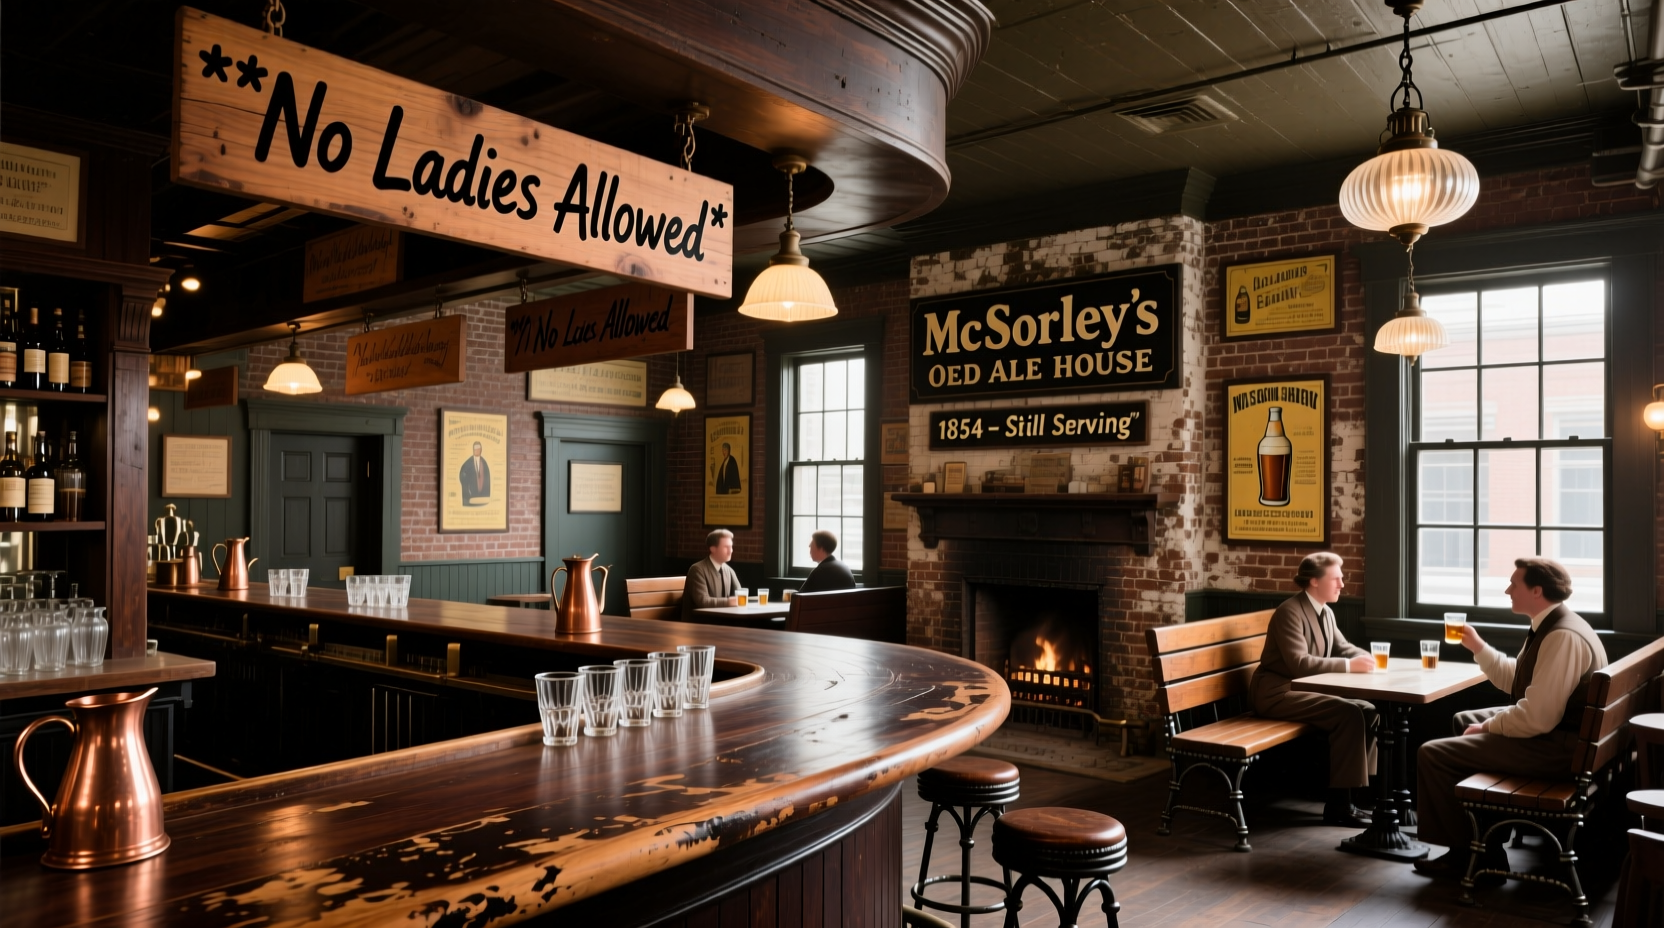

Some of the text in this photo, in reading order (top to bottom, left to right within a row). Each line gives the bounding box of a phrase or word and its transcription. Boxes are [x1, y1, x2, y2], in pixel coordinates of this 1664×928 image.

[372, 105, 541, 220] Ladies
[599, 294, 673, 343] Allowed
[928, 349, 1153, 388] OED ALE HOUSE
[938, 418, 984, 440] 1854
